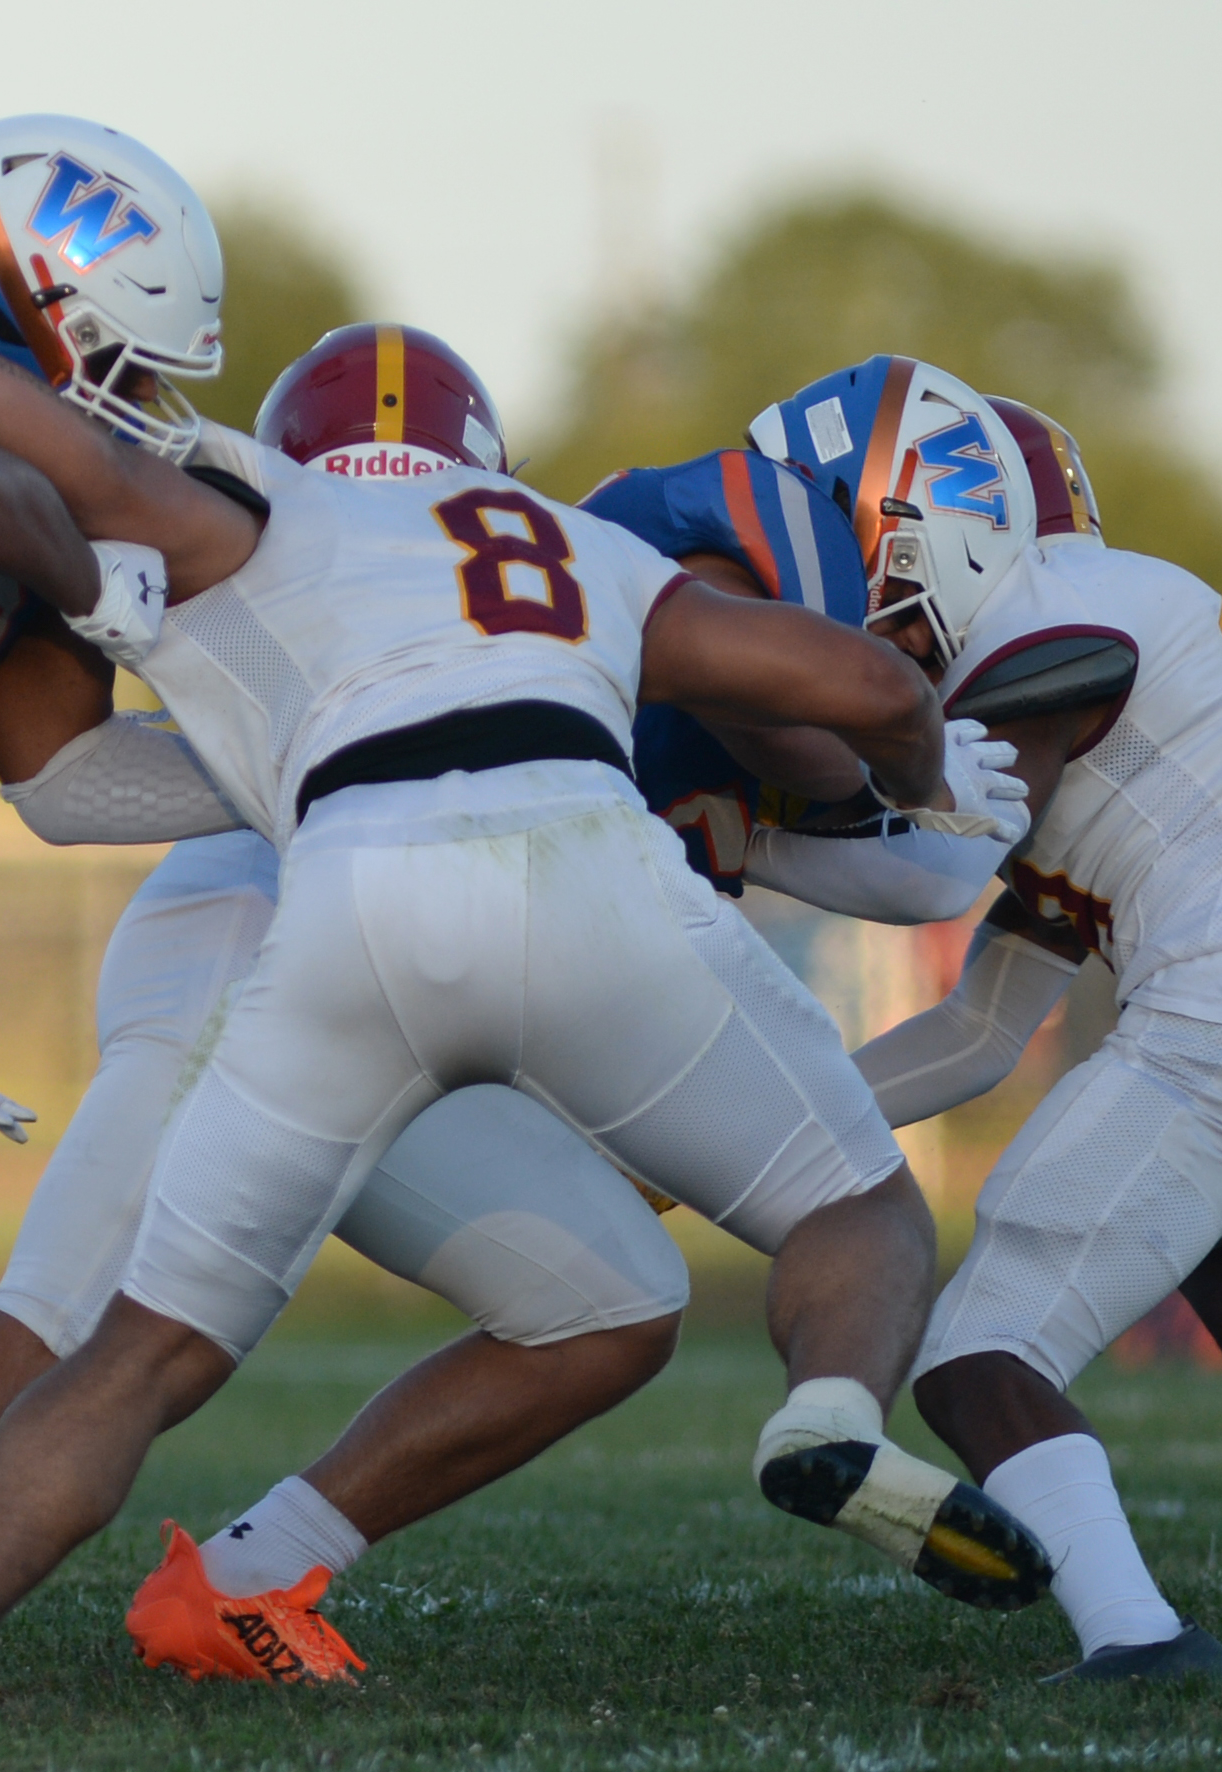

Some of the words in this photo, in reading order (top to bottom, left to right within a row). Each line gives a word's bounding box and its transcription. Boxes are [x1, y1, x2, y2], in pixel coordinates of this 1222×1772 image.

[26, 151, 160, 275] W
[325, 450, 456, 477] Ridde
[913, 412, 1010, 531] W
[429, 486, 590, 646] 8
